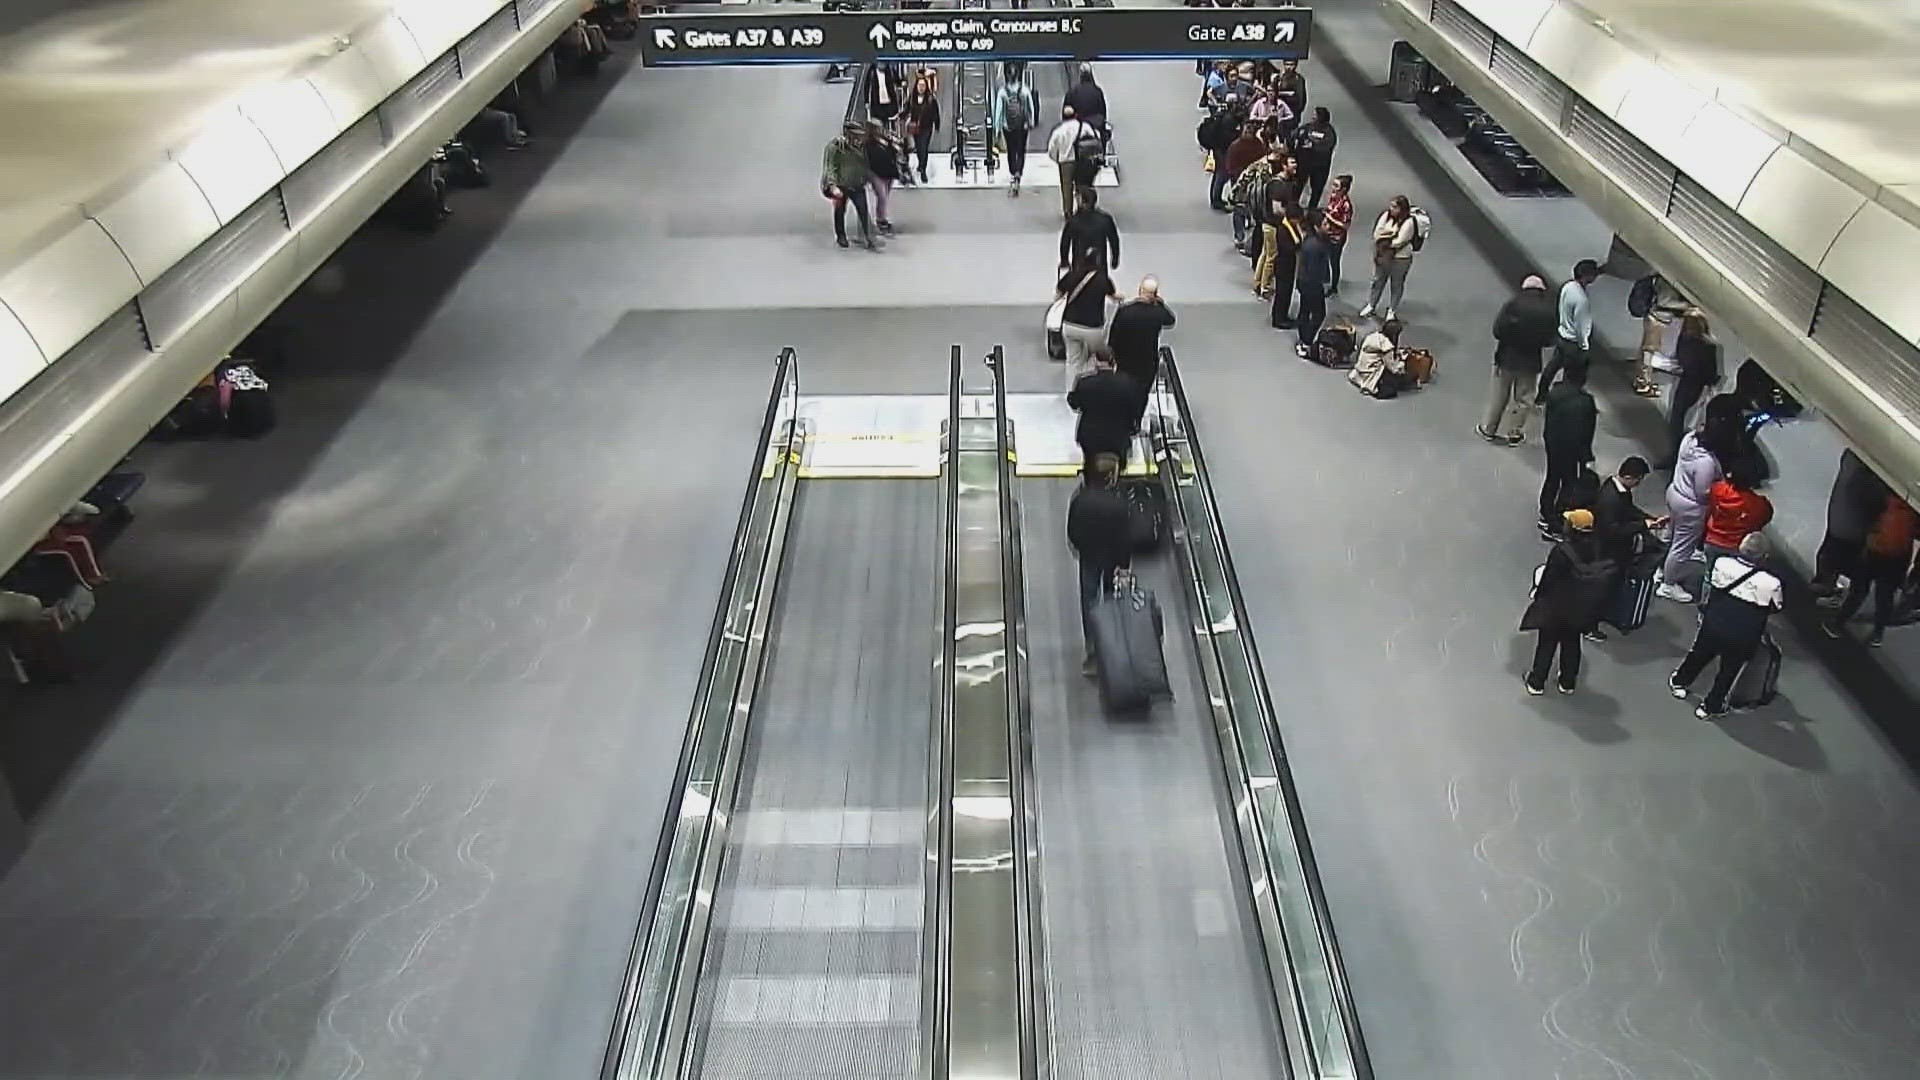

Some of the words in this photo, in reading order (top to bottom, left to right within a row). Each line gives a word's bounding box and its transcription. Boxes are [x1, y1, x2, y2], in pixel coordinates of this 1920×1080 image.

[895, 21, 948, 37] Baggage
[951, 19, 987, 35] Claim,
[990, 19, 1058, 34] Concourses
[1061, 18, 1081, 34] B,C
[1188, 25, 1226, 41] Gate
[1231, 24, 1266, 41] A38
[685, 30, 732, 48] Gates
[735, 28, 768, 46] A37
[772, 29, 786, 46] &
[790, 28, 823, 46] A39
[896, 39, 928, 51] Gates
[930, 39, 953, 51] A40
[955, 39, 969, 50] to
